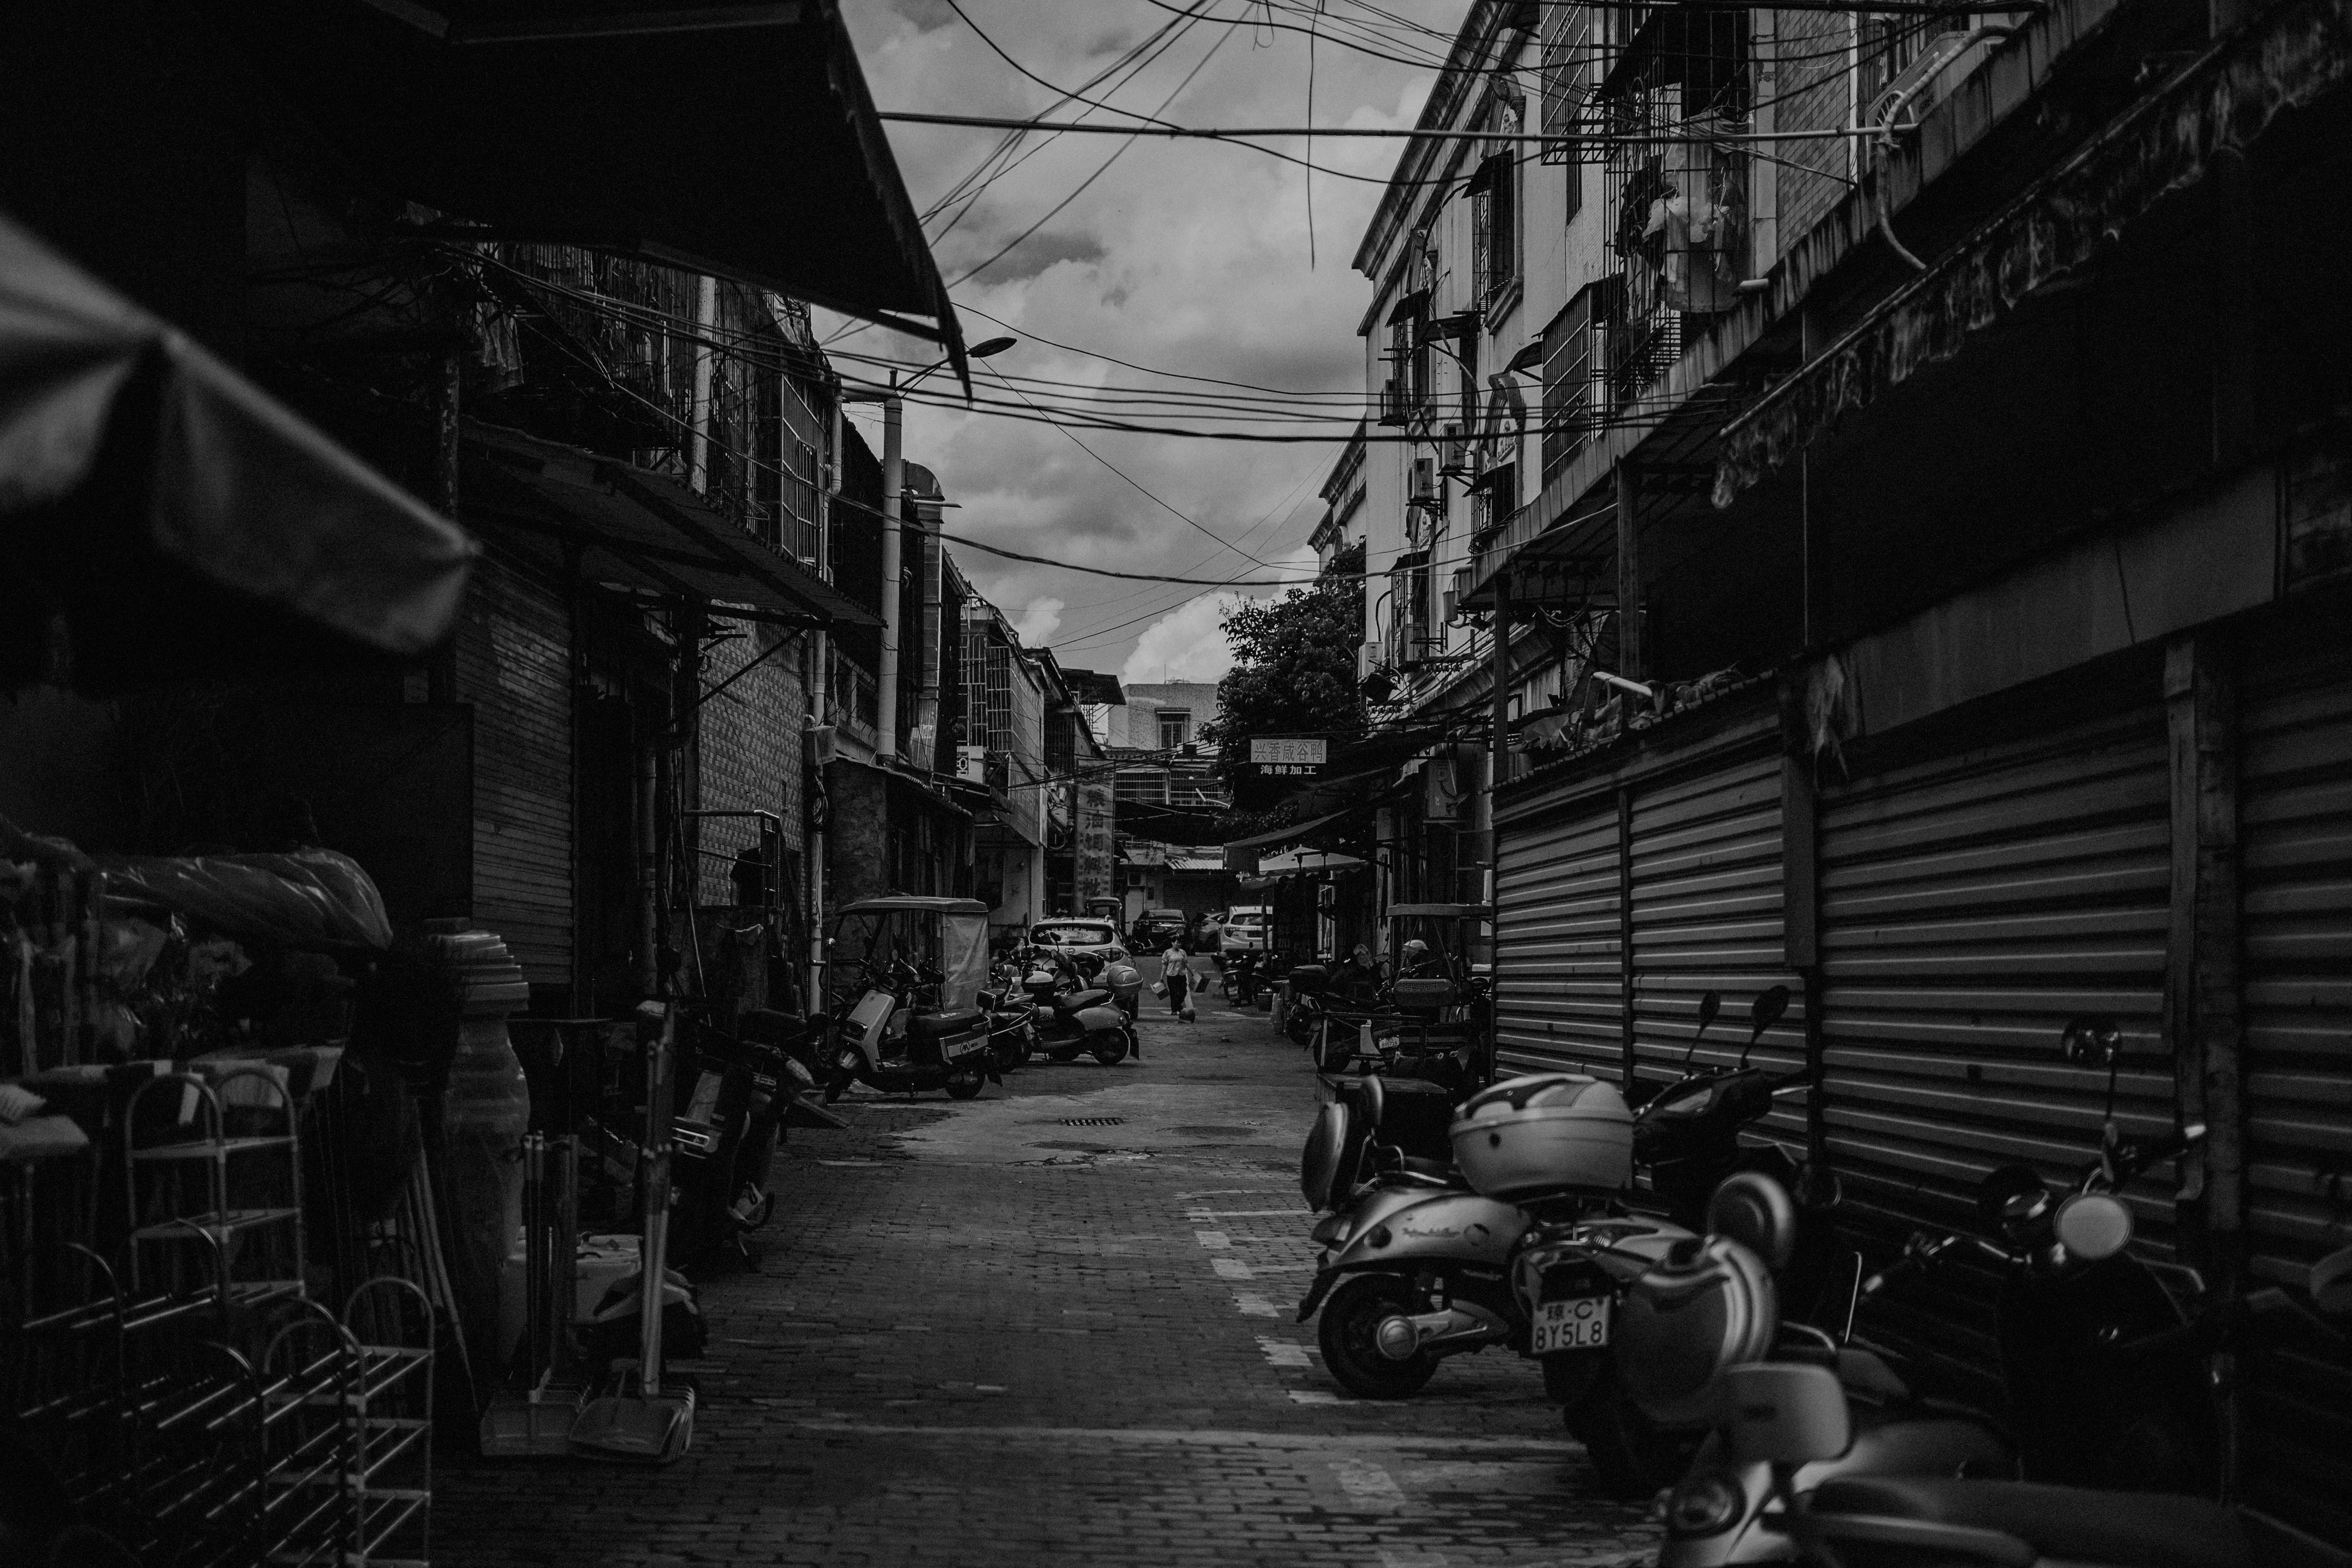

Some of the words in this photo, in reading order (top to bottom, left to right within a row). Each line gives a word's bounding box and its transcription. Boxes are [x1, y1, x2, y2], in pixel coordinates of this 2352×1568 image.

[1254, 742, 1323, 762] 兴香咸谷鸭
[1260, 765, 1317, 775] 海鲜加工
[1403, 982, 1440, 991] 海鲜加工
[1535, 1321, 1603, 1349] 8Y5L8
